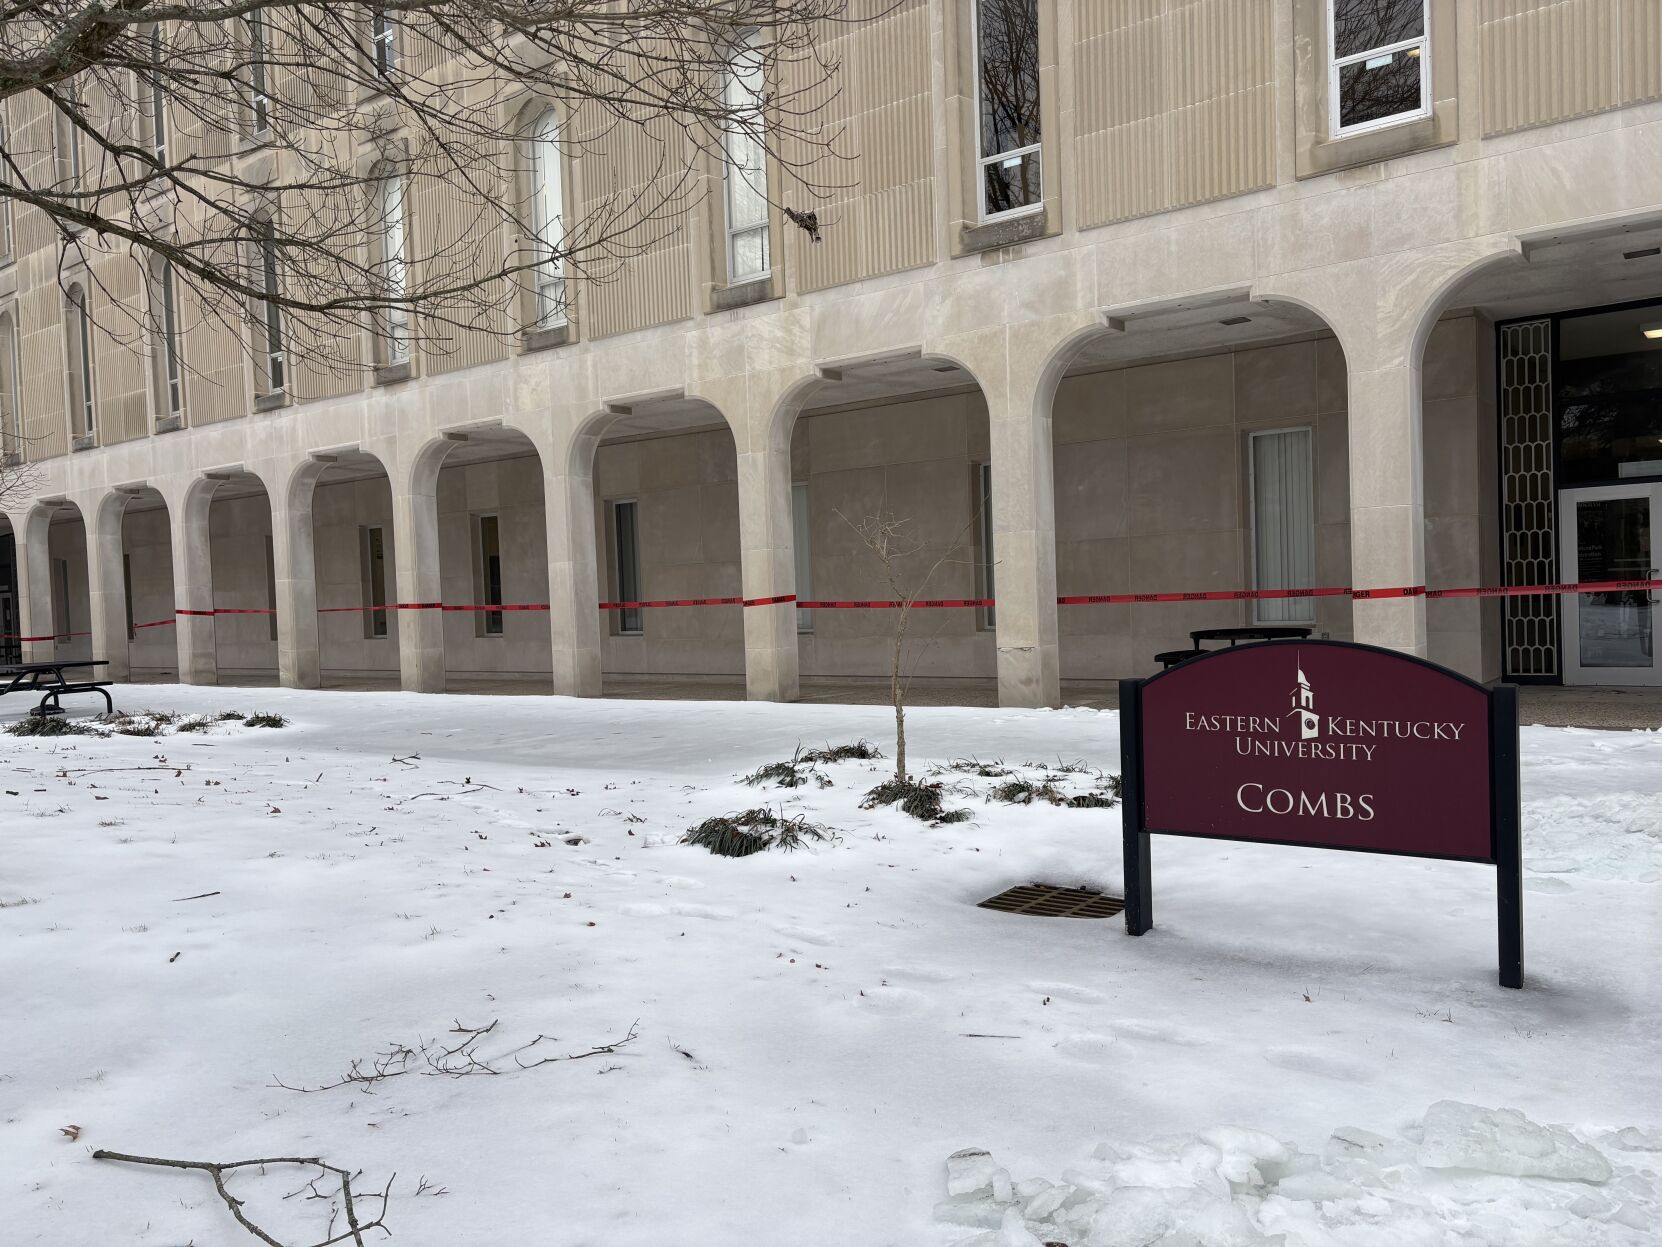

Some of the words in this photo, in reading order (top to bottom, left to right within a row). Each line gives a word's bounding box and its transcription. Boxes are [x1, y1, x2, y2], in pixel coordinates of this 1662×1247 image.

[1185, 712, 1280, 733] EASTERN
[1327, 716, 1465, 740] KENTUCKY
[1235, 736, 1377, 761] UNIVERSITY
[1236, 782, 1376, 821] COMBS
